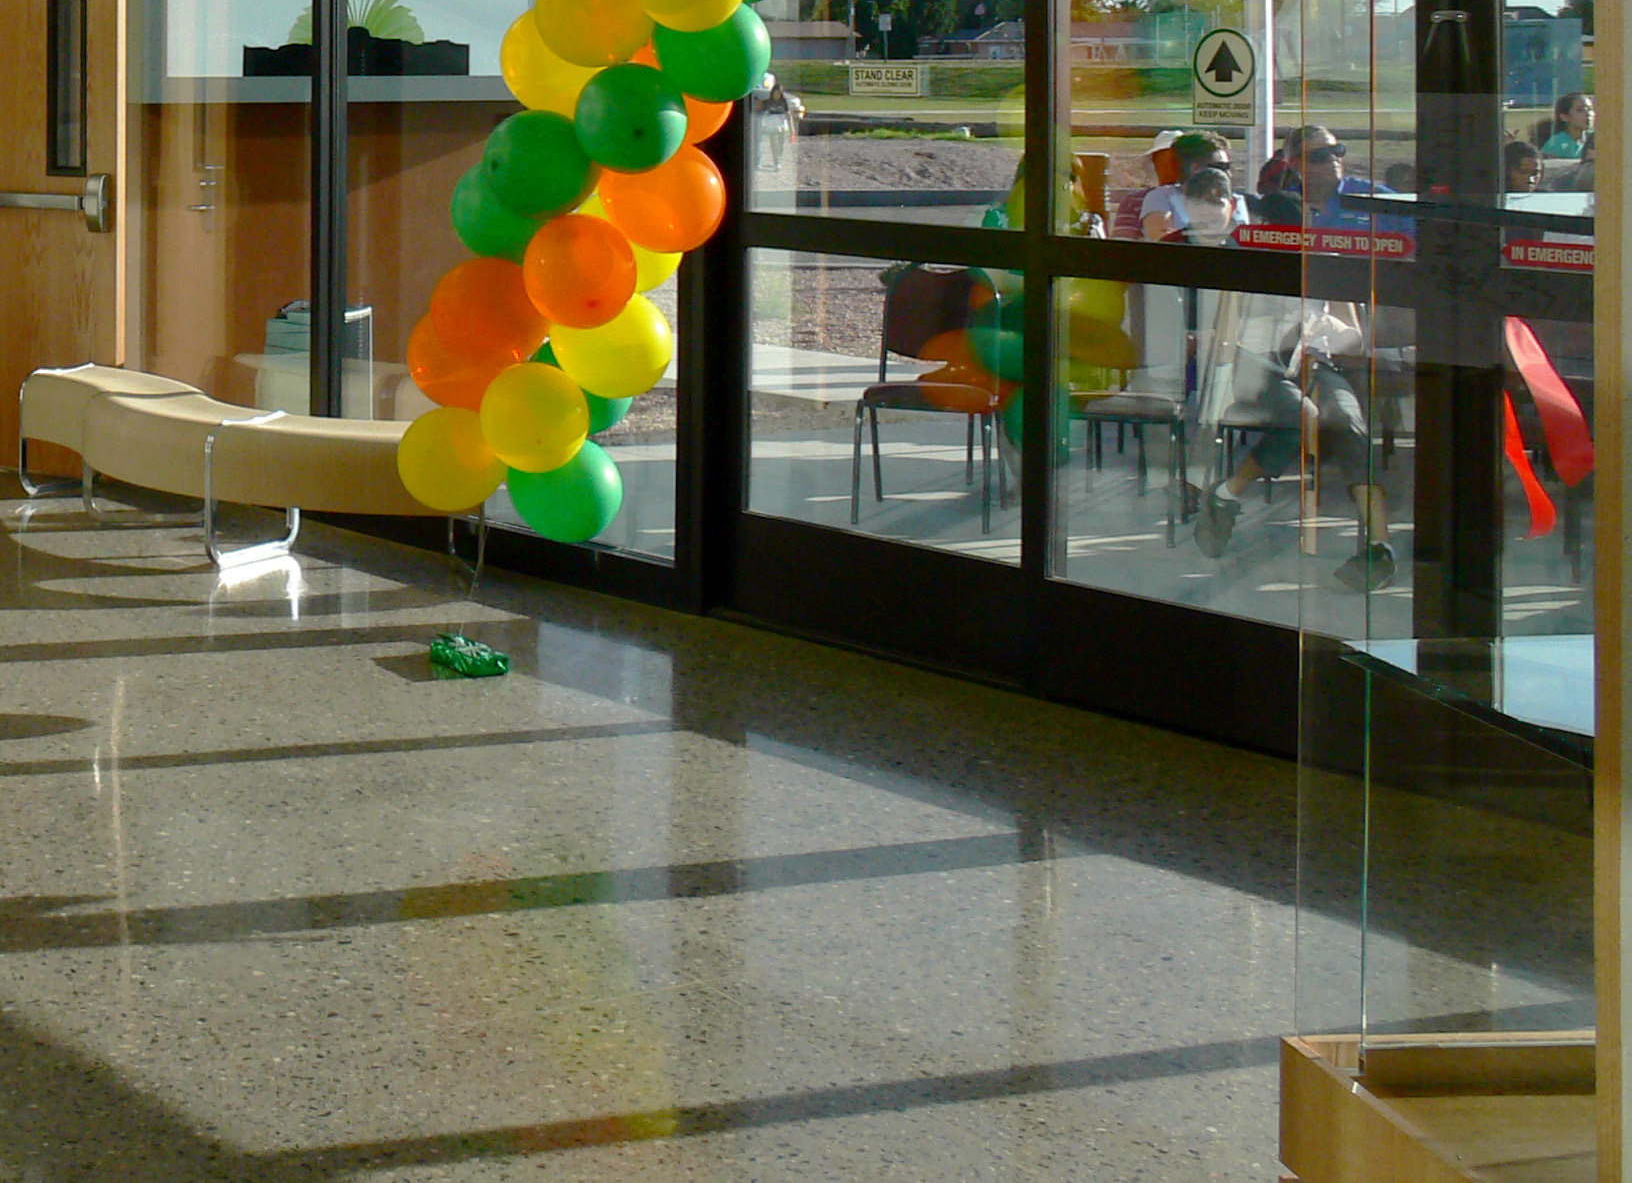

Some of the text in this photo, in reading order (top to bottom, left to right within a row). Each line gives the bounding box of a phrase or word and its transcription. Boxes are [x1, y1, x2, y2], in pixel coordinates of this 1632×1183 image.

[854, 69, 914, 81] STAND CLEAR
[1219, 111, 1249, 119] MOVING
[1239, 228, 1403, 253] IN EMERGENCY PUSH TO OPEN
[1511, 245, 1595, 265] IN EMERGENC
